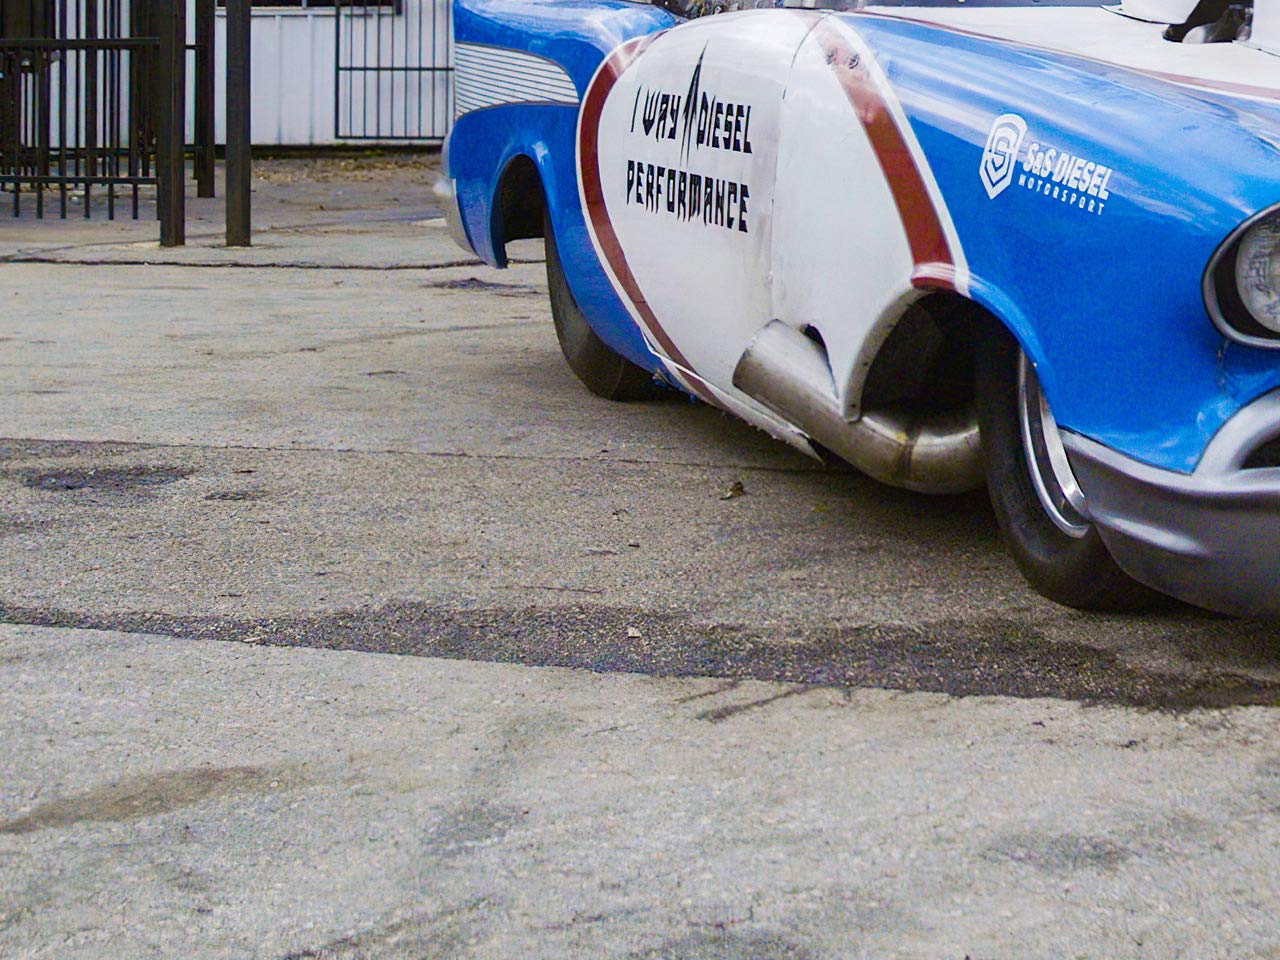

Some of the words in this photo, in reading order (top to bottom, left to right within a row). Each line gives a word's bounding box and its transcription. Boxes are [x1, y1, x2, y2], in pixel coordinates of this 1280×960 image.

[642, 88, 682, 143] WAY
[696, 91, 752, 154] DIESEL
[626, 159, 750, 234] PERFORMANCE
[1018, 174, 1105, 216] MOTORSPORT
[1051, 151, 1113, 201] DIESEL
